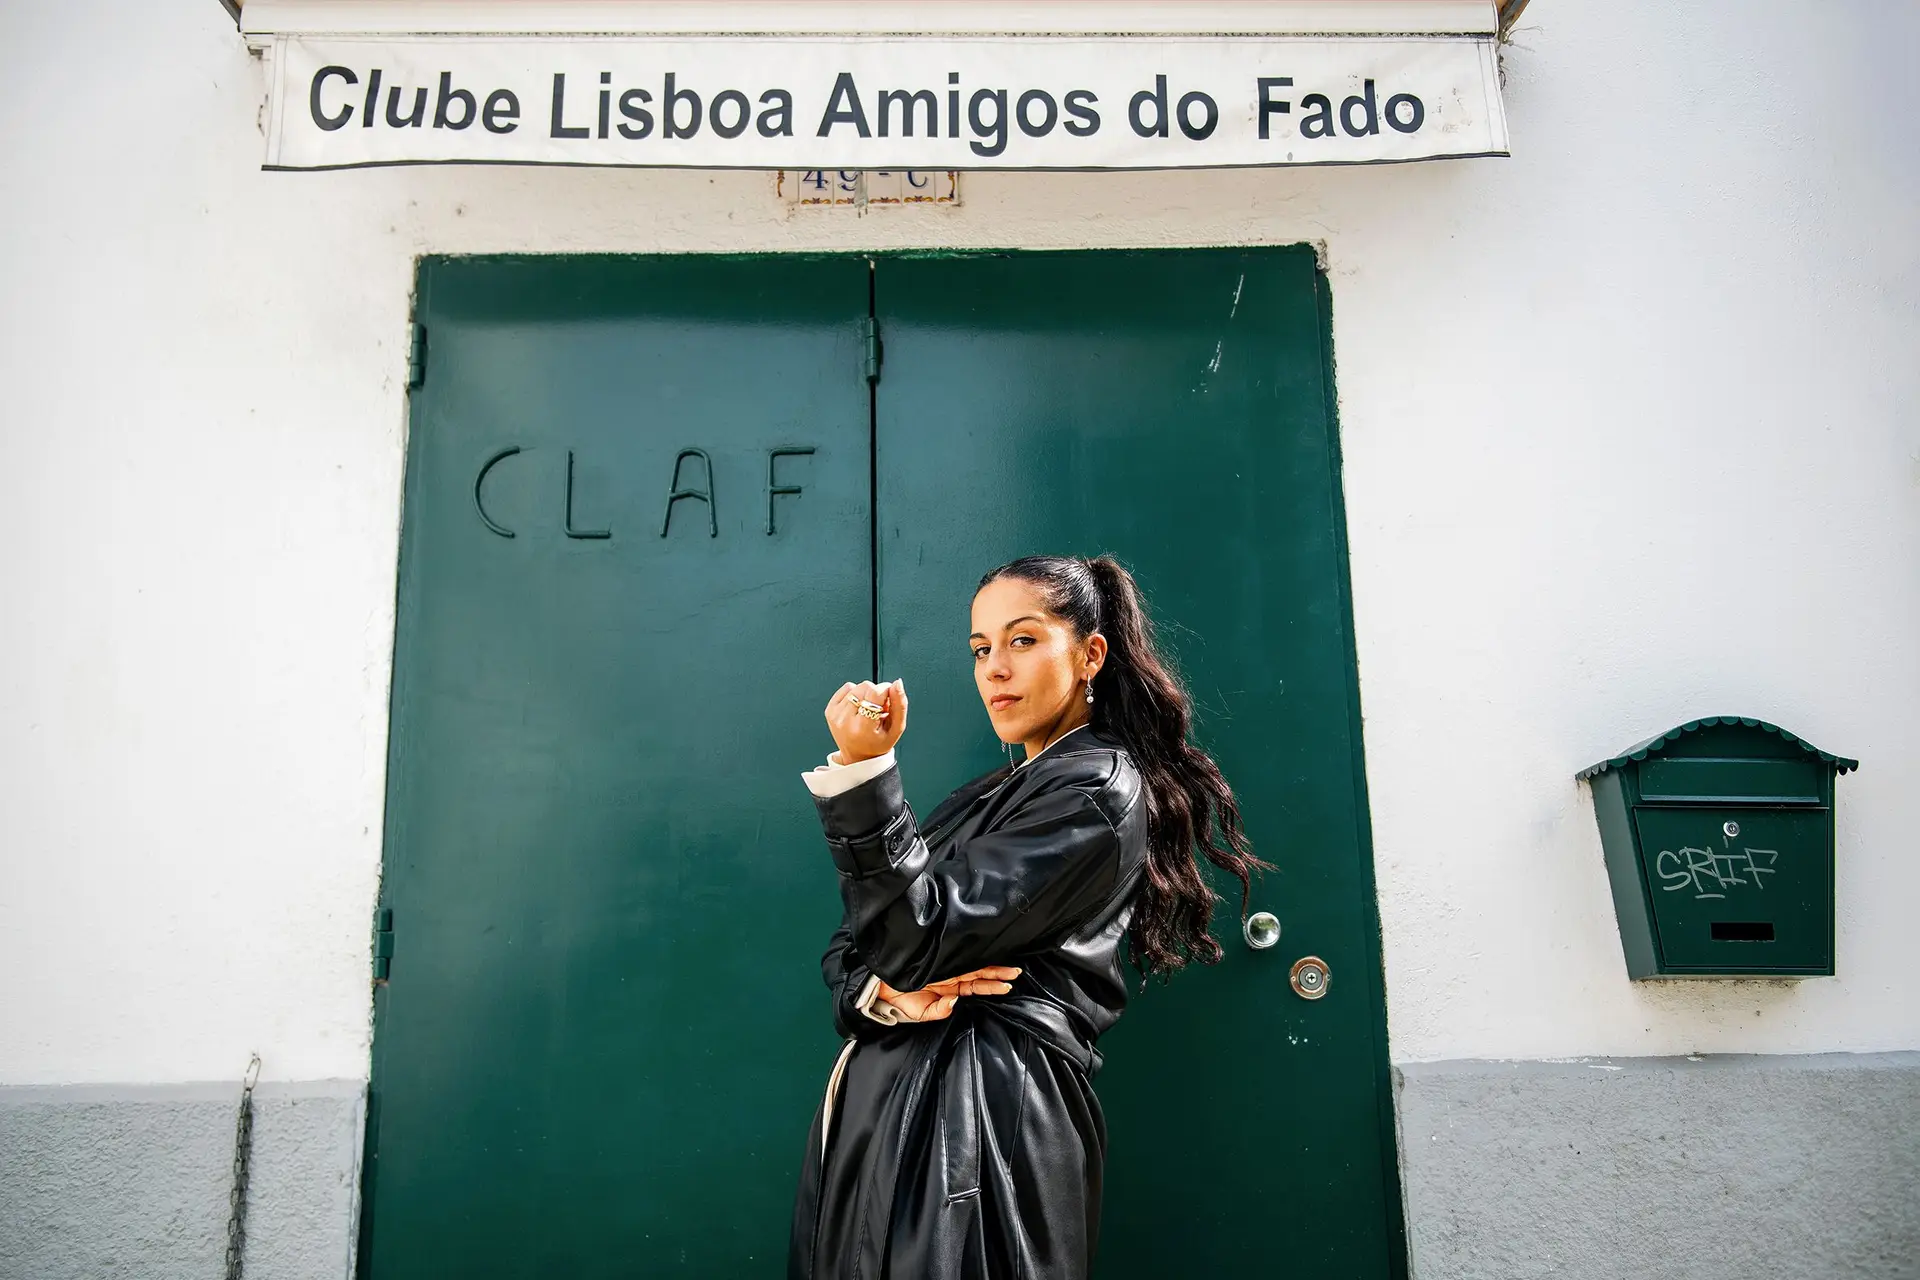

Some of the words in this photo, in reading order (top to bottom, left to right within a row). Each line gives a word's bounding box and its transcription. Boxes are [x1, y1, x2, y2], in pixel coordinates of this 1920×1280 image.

[309, 65, 521, 134] Clube
[550, 71, 795, 140] Lisboa
[816, 71, 1101, 158] Amigos
[1128, 74, 1219, 141] do
[1257, 76, 1425, 140] Fado
[473, 446, 815, 540] CLAF
